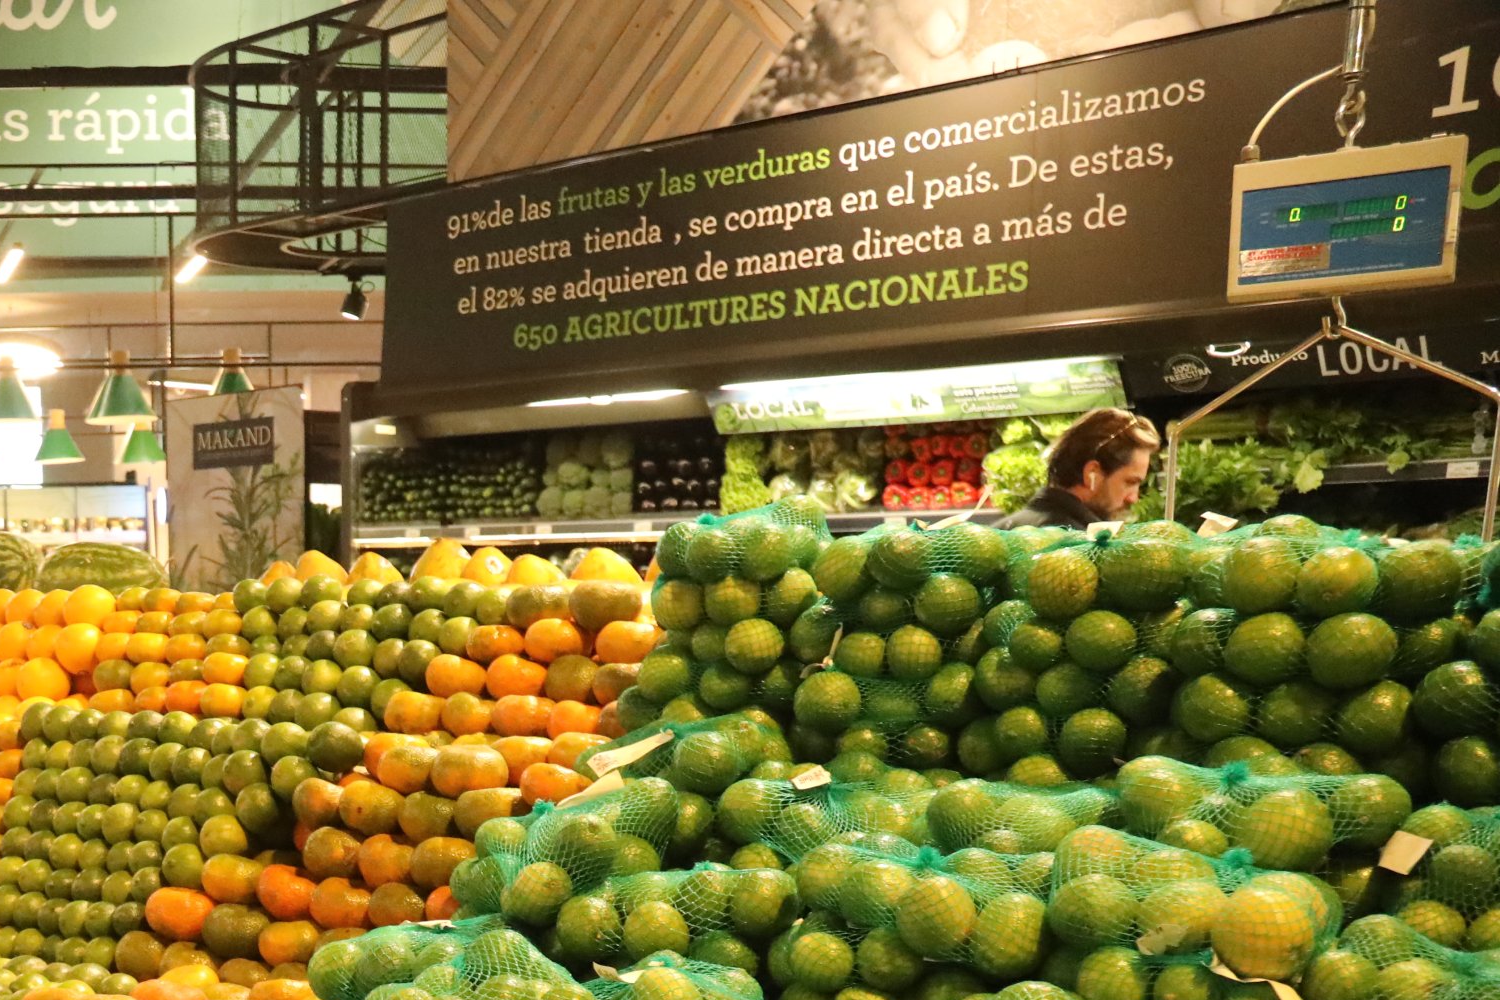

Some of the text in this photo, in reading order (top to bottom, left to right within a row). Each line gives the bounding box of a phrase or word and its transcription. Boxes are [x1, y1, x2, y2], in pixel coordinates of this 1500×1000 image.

[1431, 45, 1500, 118] 1
[520, 195, 551, 224] las
[557, 186, 630, 216] frutas
[637, 180, 654, 208] y
[660, 168, 696, 198] las
[704, 148, 831, 189] verduras
[839, 136, 896, 172] que
[903, 78, 1206, 155] comercializamos
[454, 254, 480, 275] en
[485, 238, 572, 271] nuestra
[584, 217, 662, 253] tienda
[688, 215, 717, 238] se
[724, 196, 833, 231] compra
[840, 188, 879, 214] en
[886, 170, 915, 207] el
[923, 162, 999, 209] país.
[1008, 153, 1058, 188] De
[1069, 142, 1174, 177] estas,
[457, 193, 1128, 315] el 82% se adquieren de manera directa a más de
[513, 260, 1029, 351] 650 AGRICULTURES NACIONALES
[1316, 335, 1443, 378] LOCAL
[197, 425, 271, 451] MAKAND
